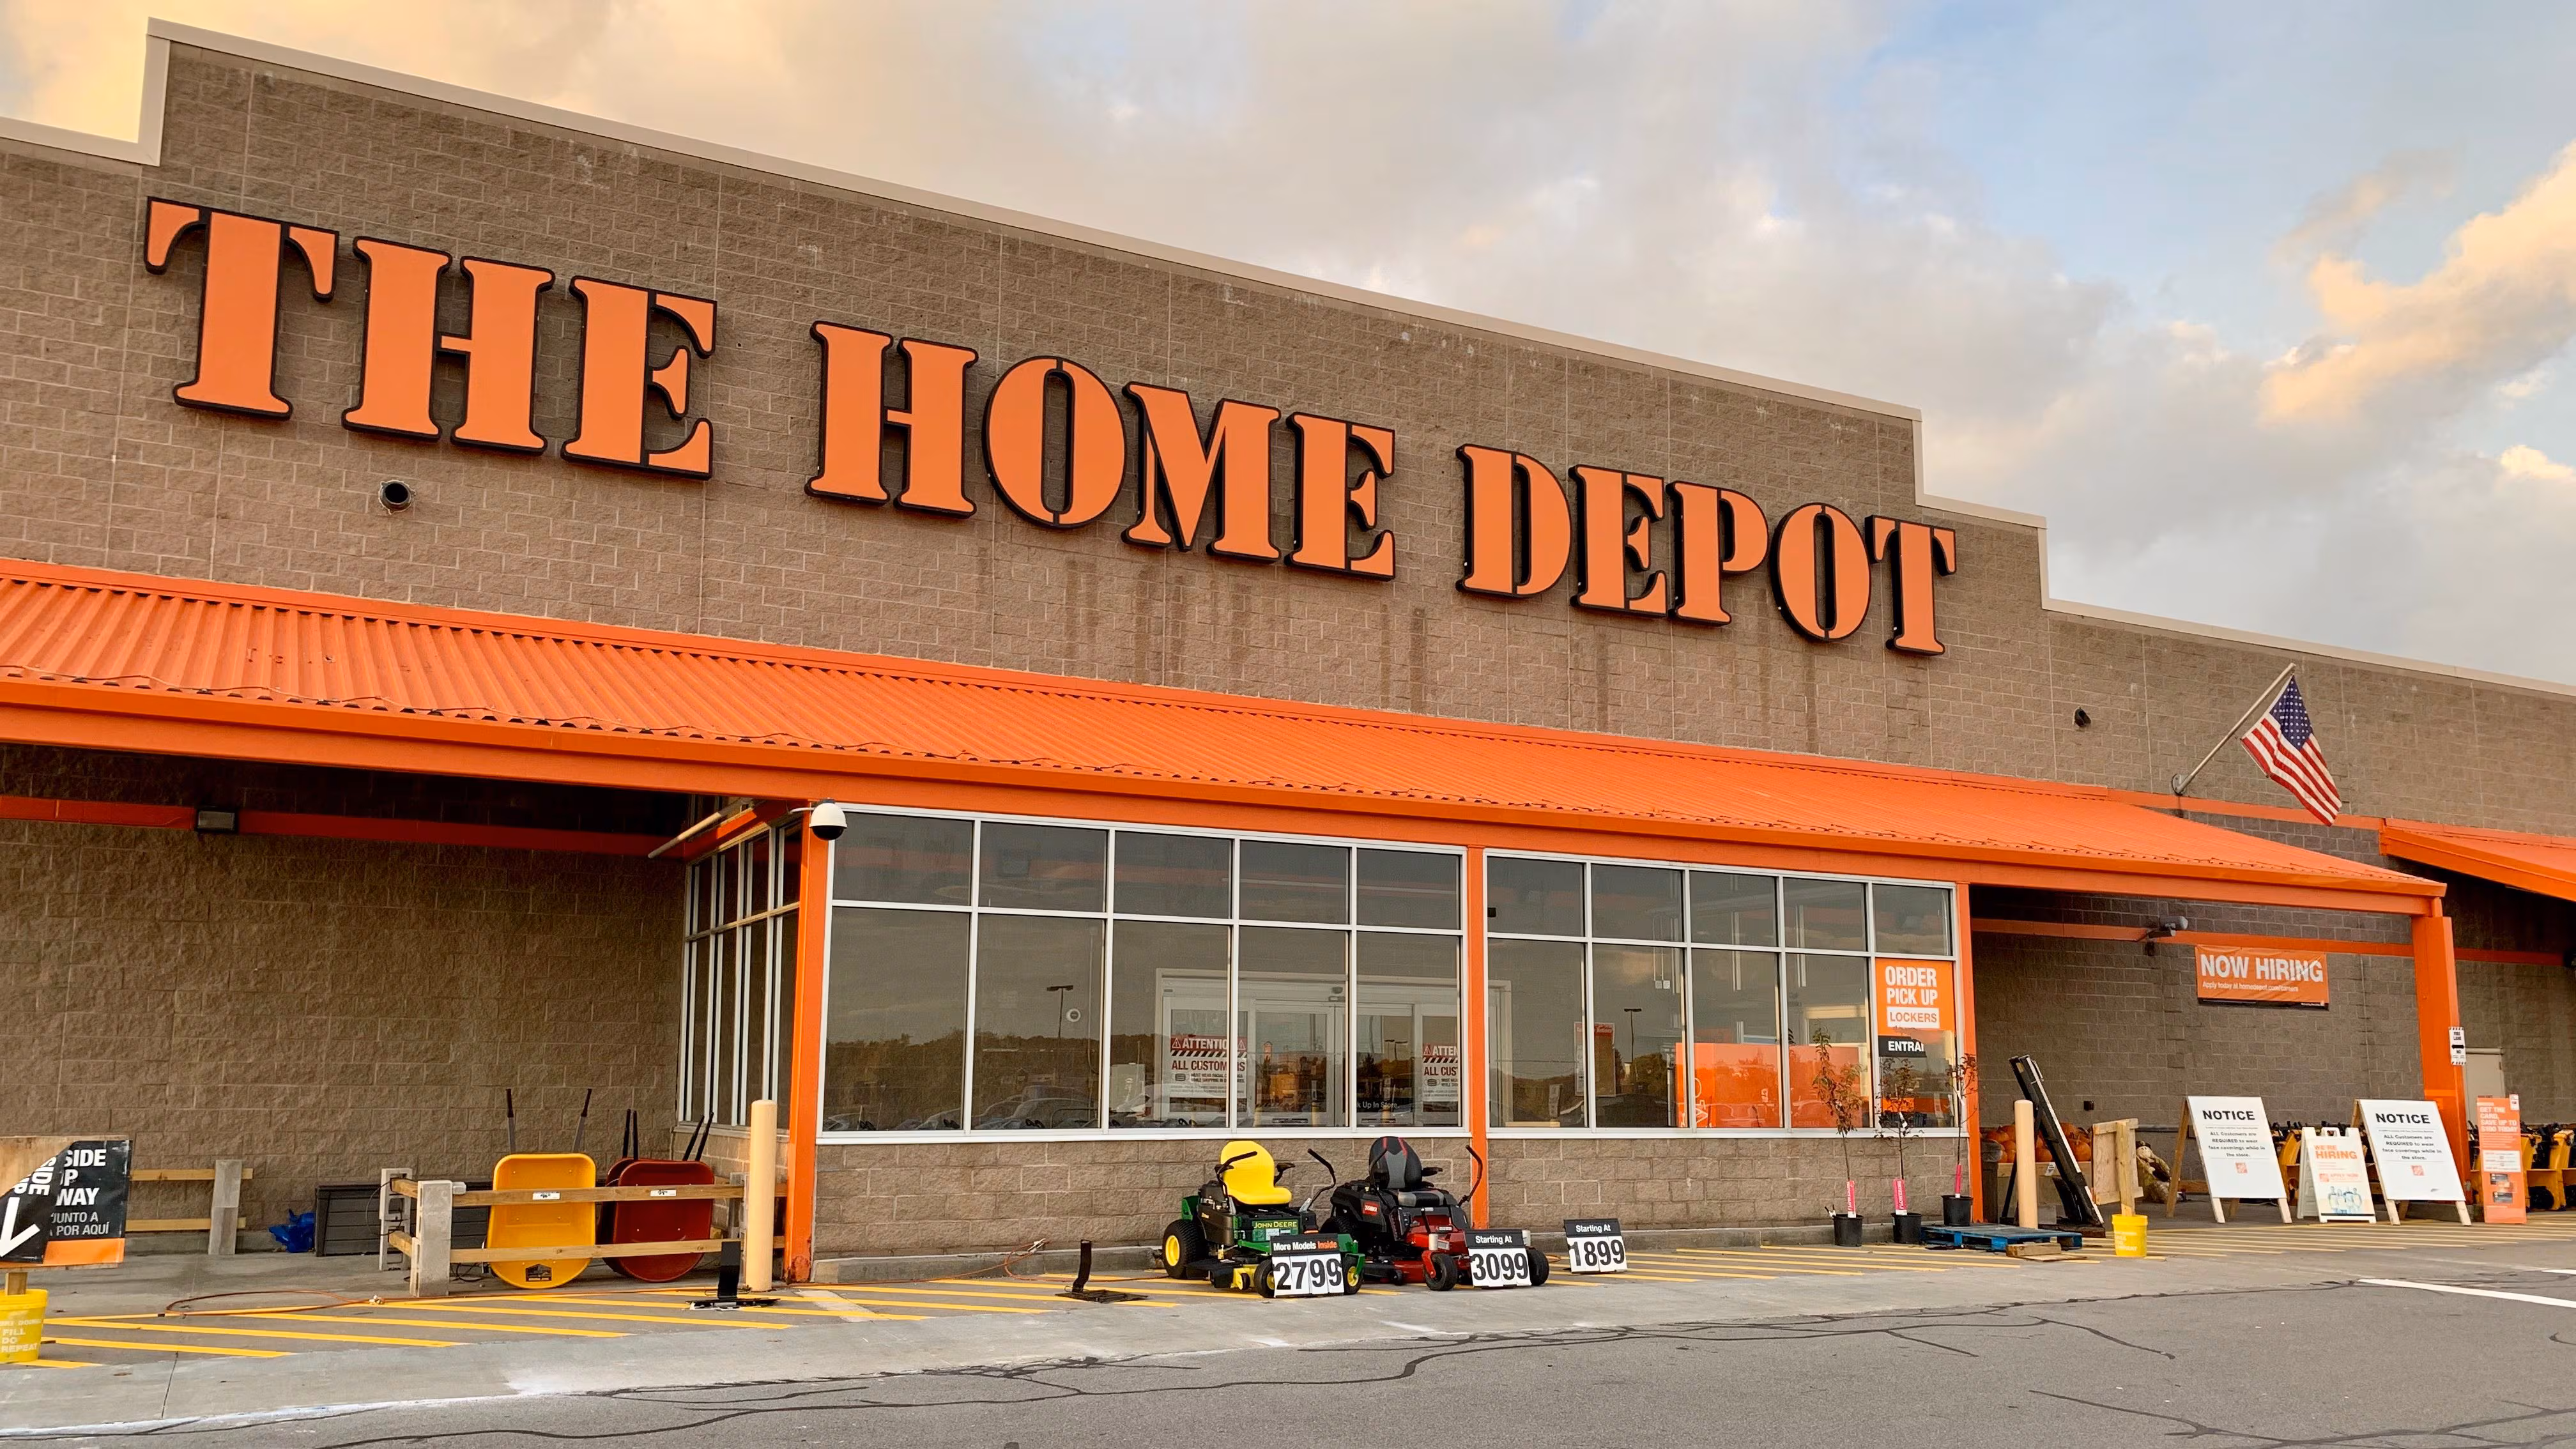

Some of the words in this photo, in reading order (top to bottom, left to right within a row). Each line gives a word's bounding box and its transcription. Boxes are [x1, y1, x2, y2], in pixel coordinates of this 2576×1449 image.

[144, 196, 717, 480] THE
[804, 320, 1395, 581] HOME
[1455, 443, 1956, 656] DEPOT
[2200, 954, 2249, 978] NOW
[2255, 957, 2324, 982] HIRING
[1885, 966, 1937, 987] ORDER
[2202, 981, 2216, 990] Apply
[2218, 982, 2232, 990] today
[1886, 988, 1917, 1005] PICK
[1920, 989, 1938, 1006] UP
[1890, 1012, 1938, 1023] LOCKERS
[1182, 1038, 1227, 1050] ATTENTIO
[1172, 1061, 1188, 1070] ALL
[1424, 1067, 1439, 1076] ALL
[1363, 1101, 1371, 1109] Up
[2202, 1110, 2255, 1120] NOTICE
[2375, 1113, 2430, 1124] NOTICE
[2315, 1151, 2358, 1160] HIRING
[90, 1211, 98, 1222] A
[56, 1225, 79, 1236] POR
[82, 1222, 110, 1235] AQUÍ
[1575, 1225, 1602, 1233] Starting
[1273, 1242, 1291, 1251] More
[1292, 1241, 1316, 1250] Models
[1317, 1240, 1337, 1249] Inside
[1475, 1235, 1503, 1245] Starting
[1570, 1239, 1625, 1266] 1899
[1471, 1253, 1528, 1281] 3099
[1273, 1258, 1342, 1290] 2799
